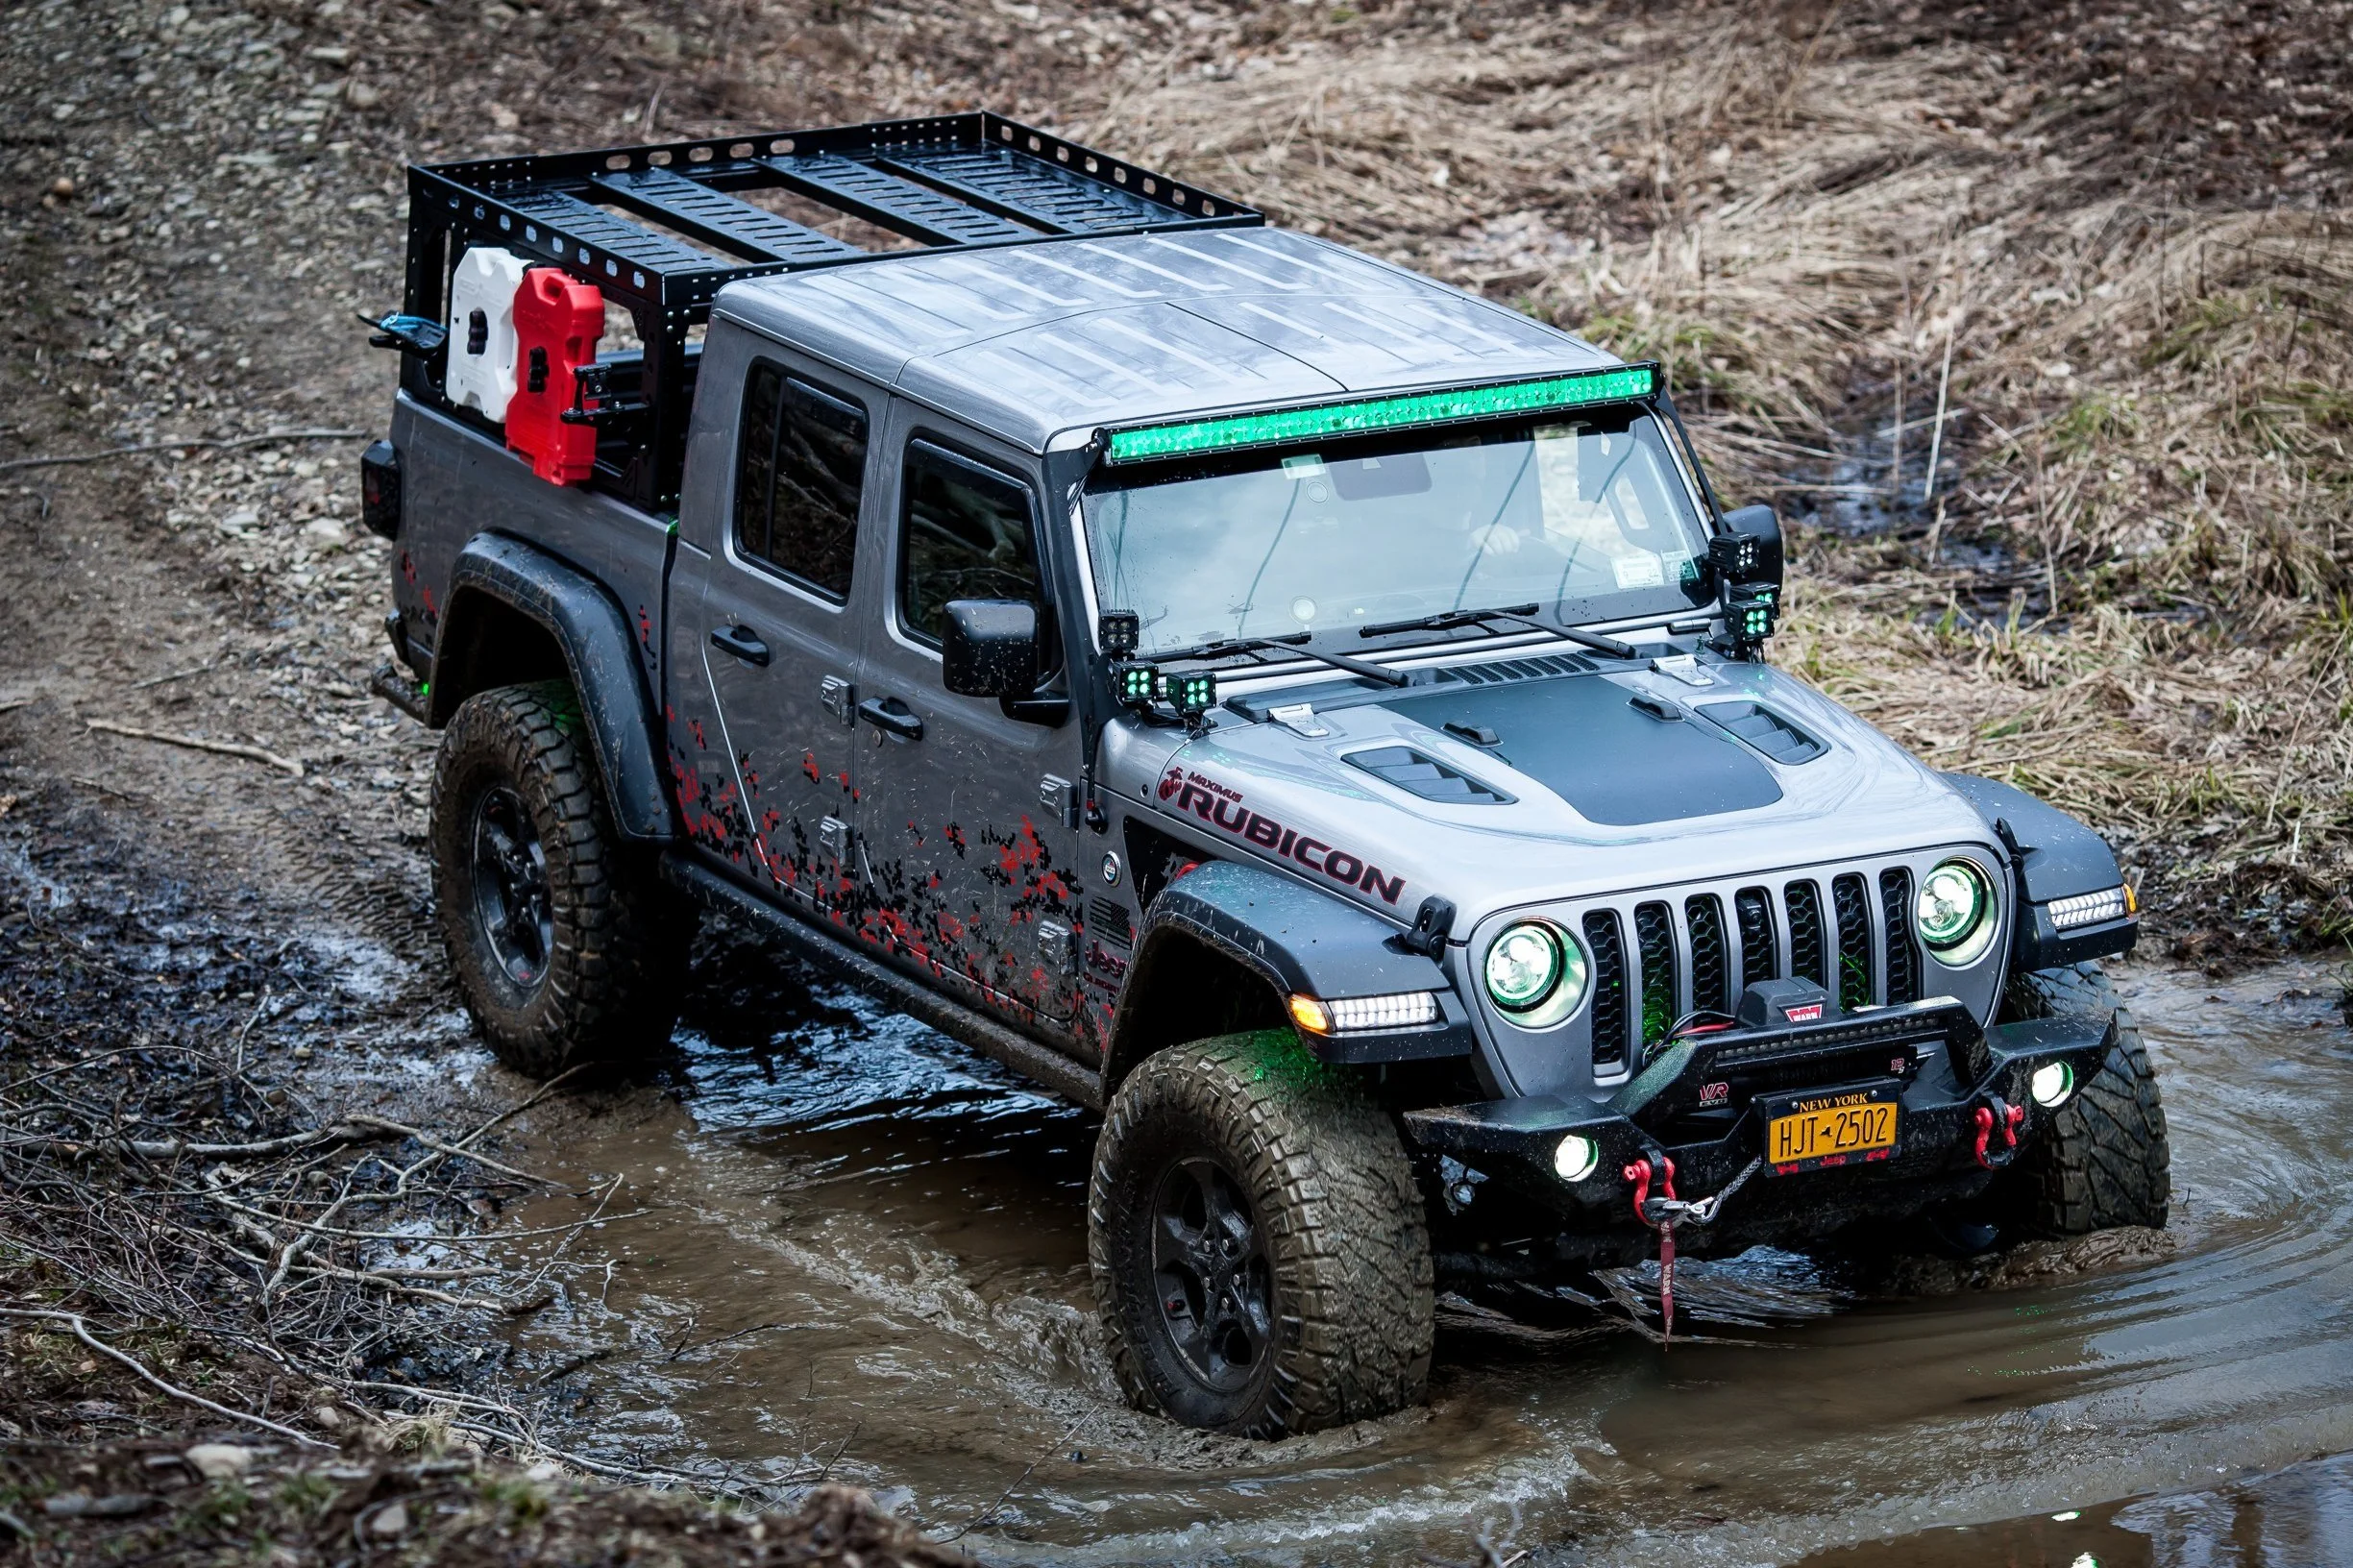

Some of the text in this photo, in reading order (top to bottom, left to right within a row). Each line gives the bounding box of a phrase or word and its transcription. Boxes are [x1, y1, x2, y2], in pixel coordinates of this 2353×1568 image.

[1188, 771, 1244, 803] MAXIMUS
[1176, 781, 1407, 906] RUBICON
[1792, 1012, 1819, 1022] WARN
[1699, 1082, 1729, 1101] VR
[1800, 1092, 1869, 1114] NEW YORK
[1779, 1107, 1889, 1158] HJT 2502
[1662, 1263, 1672, 1296] WARN
